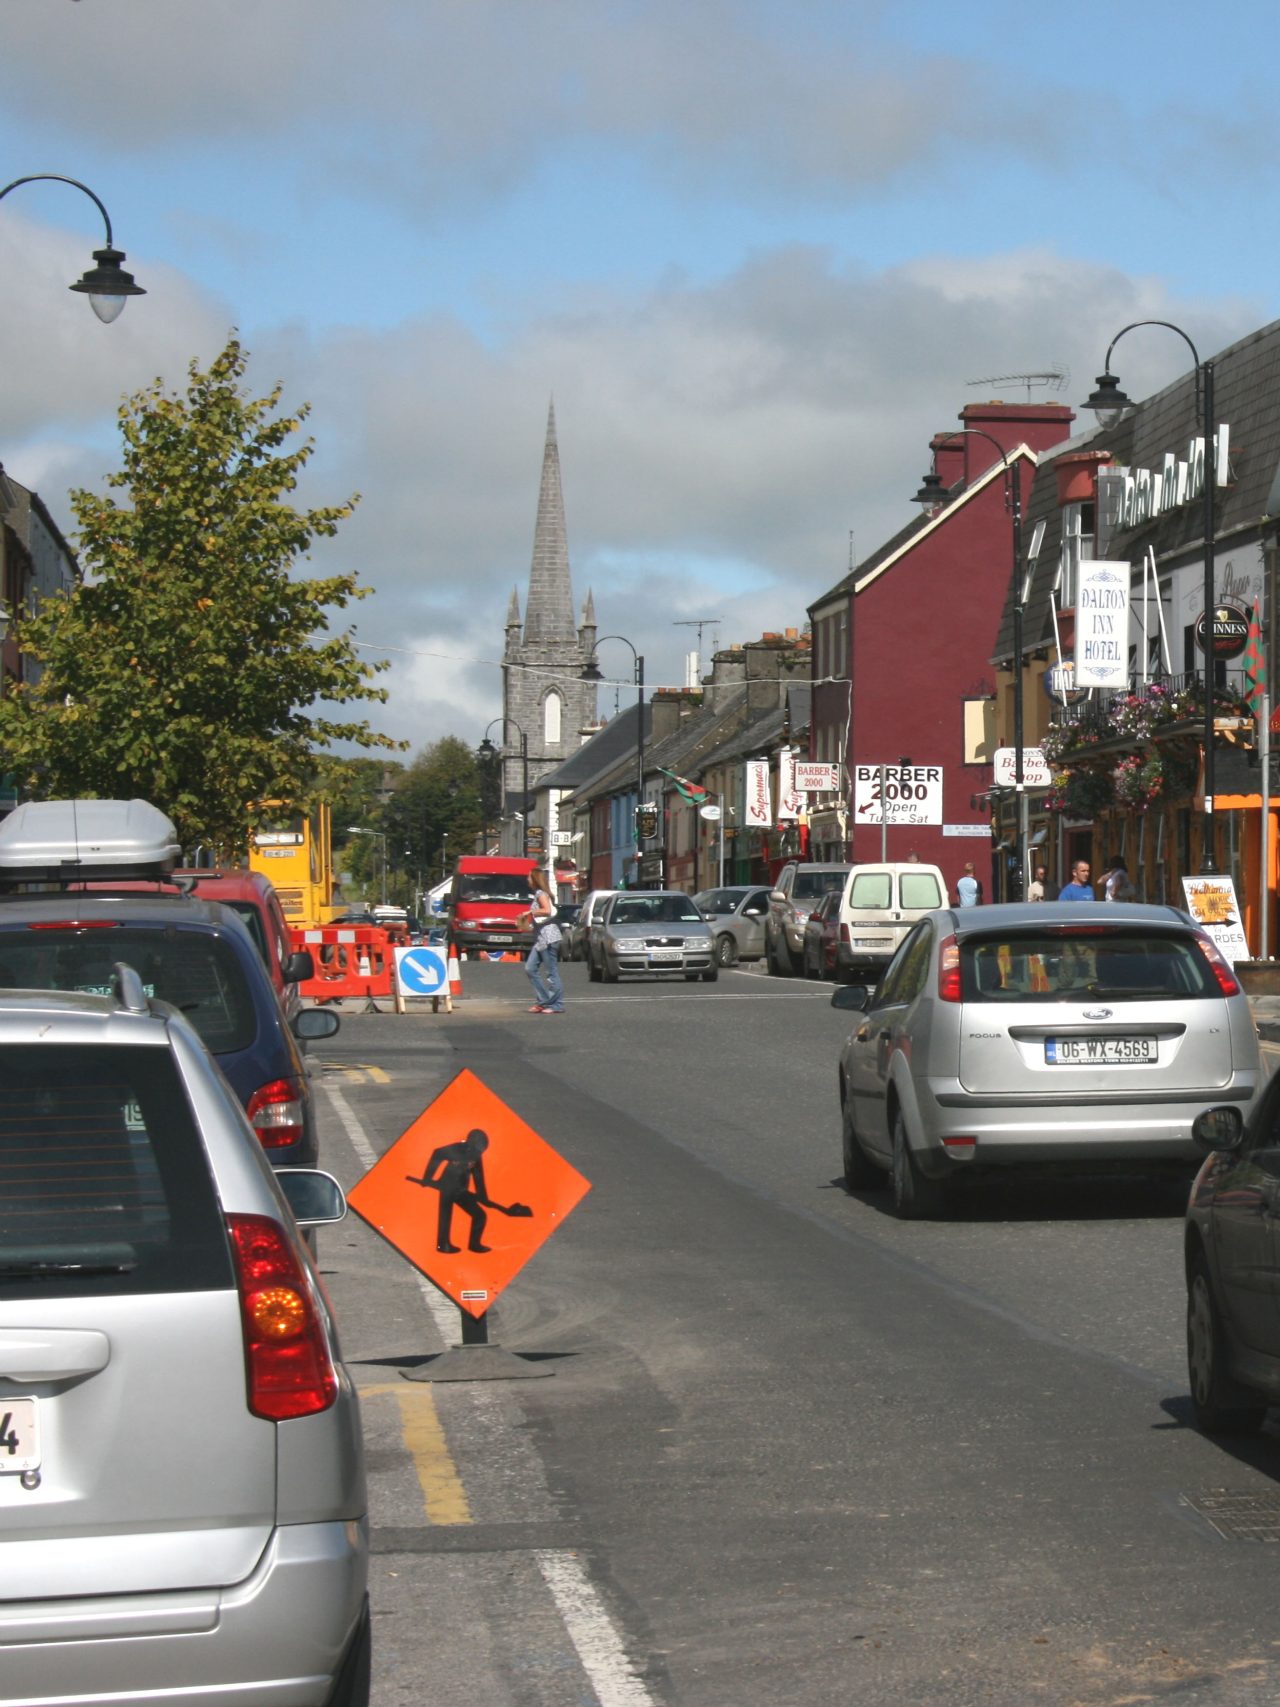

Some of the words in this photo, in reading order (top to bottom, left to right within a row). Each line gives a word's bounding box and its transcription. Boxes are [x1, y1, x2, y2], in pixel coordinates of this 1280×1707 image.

[1082, 588, 1126, 609] DALTON
[1093, 614, 1114, 635] INN
[1199, 621, 1247, 634] GINNESS
[1085, 640, 1121, 661] HOTEL
[798, 766, 830, 776] BARBER
[858, 767, 940, 782] BARBER
[1008, 771, 1042, 783] Sop
[804, 778, 823, 787] 2000
[871, 783, 928, 800] 2000
[883, 801, 917, 813] Open
[869, 813, 897, 823] Tues
[909, 813, 928, 824] Sat
[1214, 933, 1244, 944] RDES
[1062, 1039, 1150, 1059] 06-WX-4569
